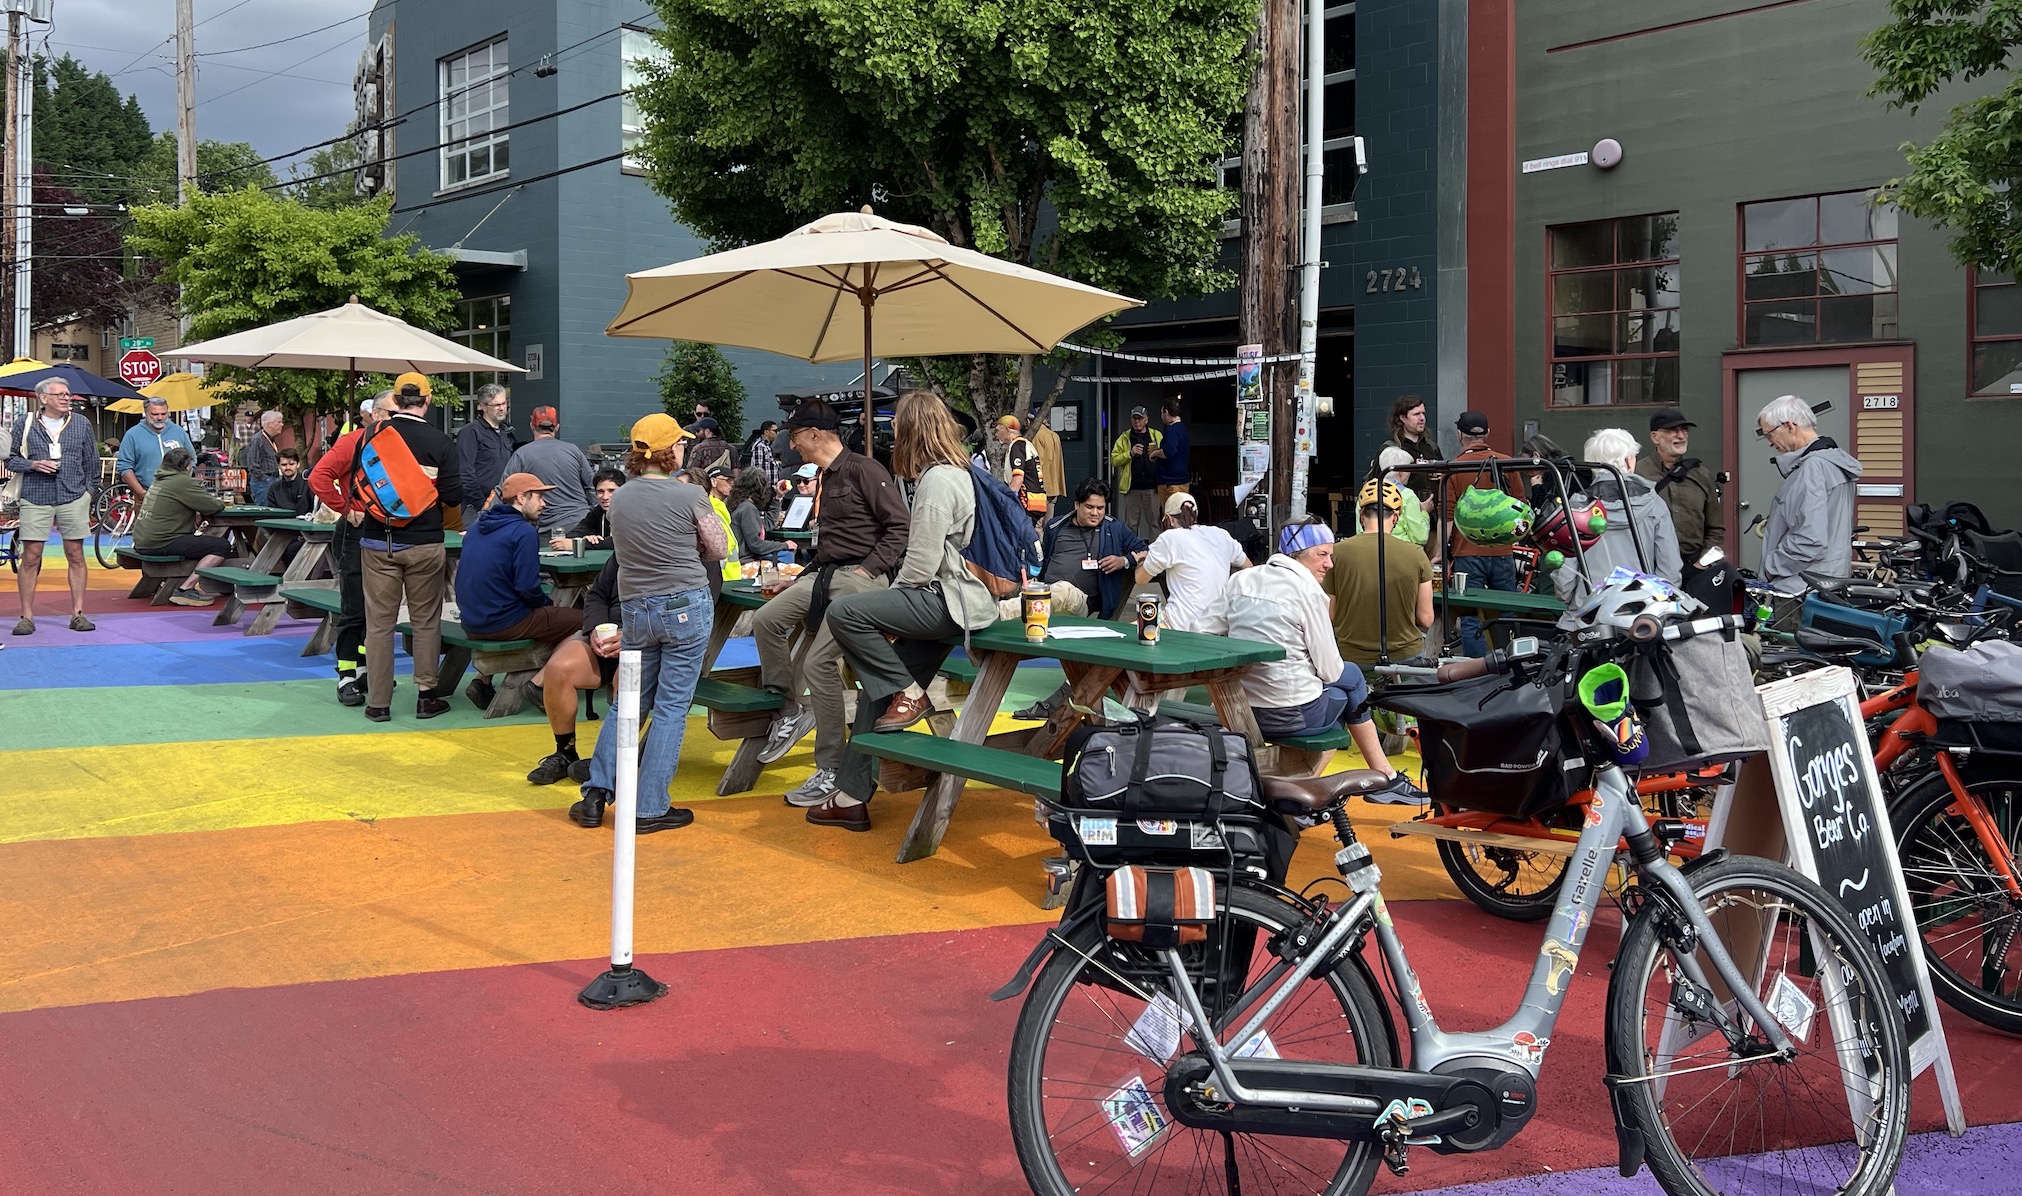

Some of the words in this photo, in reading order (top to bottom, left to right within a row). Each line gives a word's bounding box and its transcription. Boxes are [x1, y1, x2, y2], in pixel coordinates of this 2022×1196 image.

[1530, 162, 1541, 170] bell
[1543, 160, 1559, 168] rings
[1561, 156, 1573, 165] dial
[1366, 266, 1421, 293] 2724
[123, 361, 158, 376] STOP
[1865, 397, 1896, 407] 2718
[1934, 685, 1960, 698] uba
[1789, 735, 1859, 814] Gorges
[1083, 819, 1113, 830] RIDE
[1813, 814, 1844, 849] Beer
[1088, 830, 1114, 841] RIM
[1571, 849, 1598, 905] Gazelle
[1858, 903, 1884, 936] open
[1879, 895, 1894, 921] in
[1877, 930, 1907, 964] location
